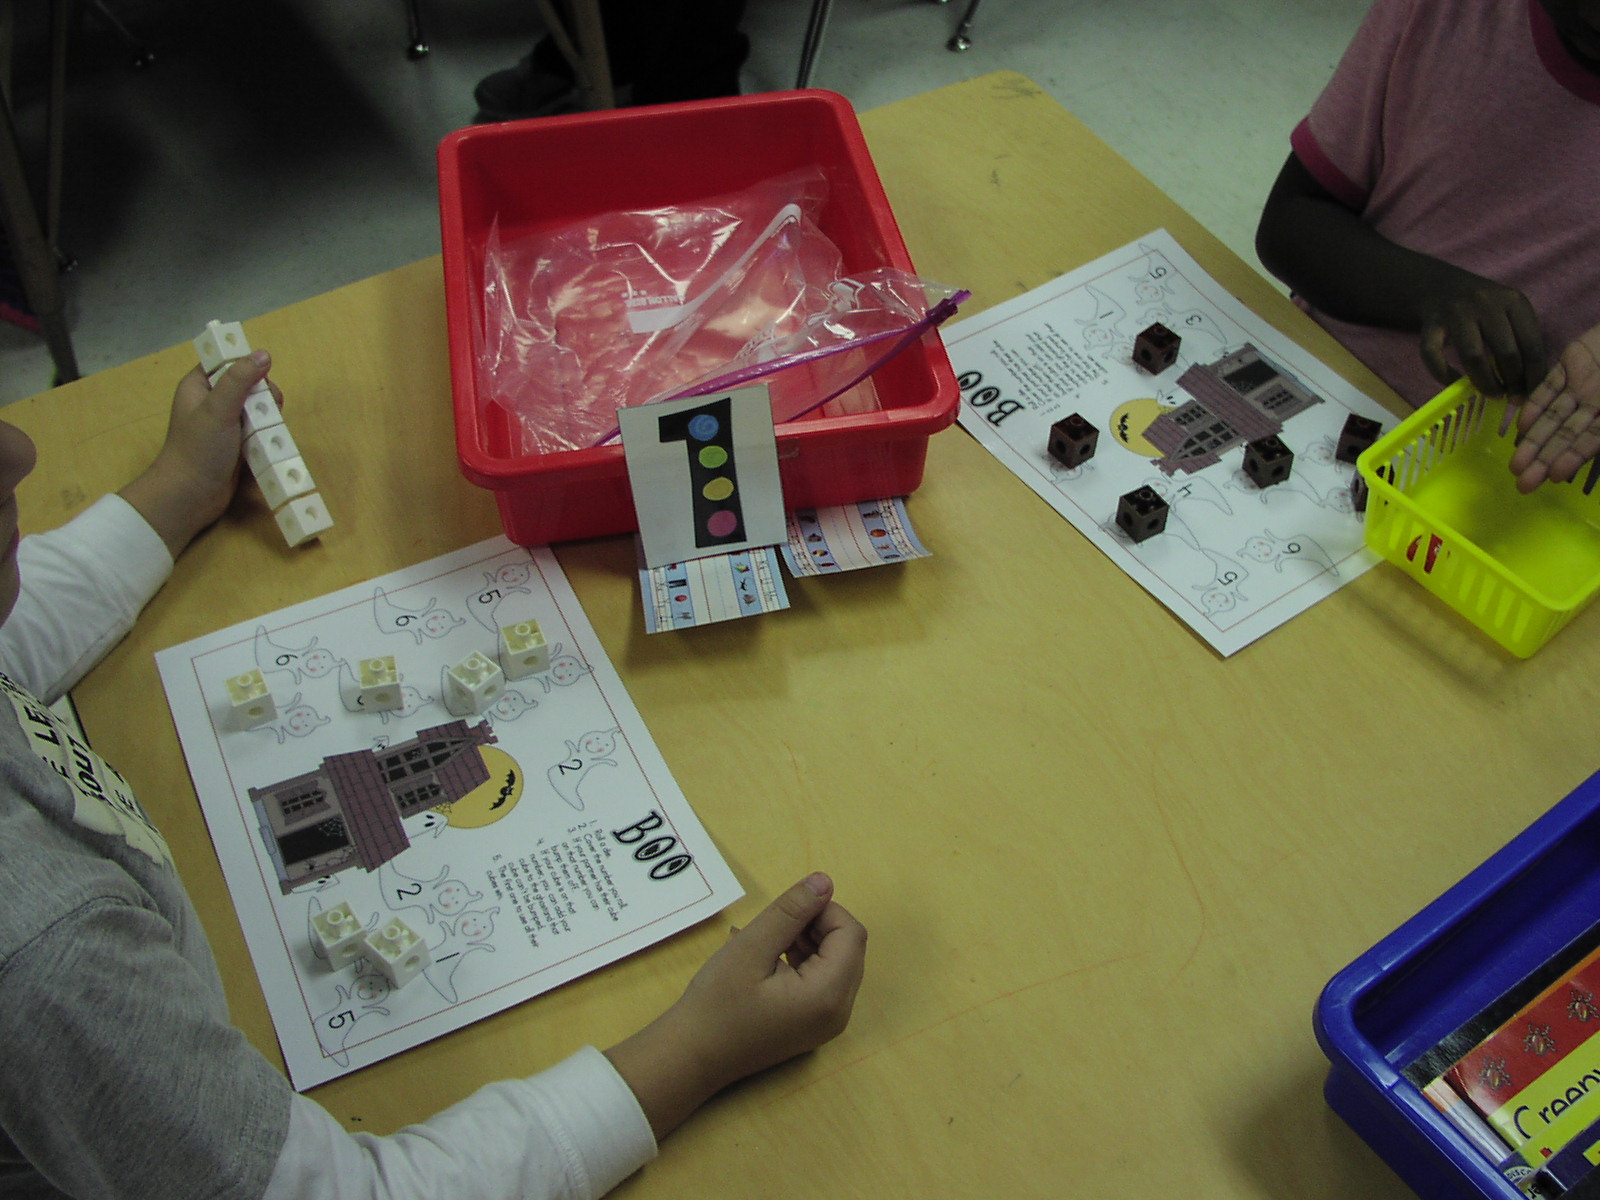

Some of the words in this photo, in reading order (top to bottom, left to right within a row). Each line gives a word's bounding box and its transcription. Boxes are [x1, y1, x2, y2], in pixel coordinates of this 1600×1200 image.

[1149, 267, 1168, 280] 5
[1185, 314, 1202, 327] 3
[957, 370, 1025, 428] BOO
[658, 397, 747, 548] 1
[1176, 484, 1193, 497] 4
[1282, 541, 1301, 555] 6
[1217, 571, 1238, 586] 5
[478, 589, 501, 606] 5
[395, 614, 417, 628] 6
[275, 652, 298, 668] 6
[558, 757, 584, 777] 2
[594, 828, 606, 841] Roll
[612, 811, 694, 881] BOO
[550, 845, 563, 863] bump
[560, 863, 571, 879] them
[583, 833, 597, 852] Cover
[594, 853, 602, 864] the
[599, 864, 614, 886] number
[608, 887, 619, 898] you
[499, 865, 507, 878] The
[508, 862, 519, 878] cube
[486, 870, 498, 889] cubes
[504, 878, 514, 891] first
[540, 879, 549, 891] you
[542, 857, 554, 870] your
[550, 871, 561, 886] cube
[566, 901, 576, 914] that
[567, 850, 577, 864] that
[574, 864, 588, 886] number
[582, 887, 593, 899] you
[590, 899, 600, 910] can
[574, 844, 586, 857] your
[580, 858, 597, 880] partner
[595, 880, 603, 892] has
[601, 892, 611, 905] their
[607, 907, 619, 922] cube
[397, 882, 422, 901] 2
[509, 892, 518, 905] one
[519, 858, 530, 874] cube
[531, 882, 539, 893] the
[550, 922, 560, 935] that
[548, 893, 557, 905] can
[519, 914, 528, 925] use
[554, 906, 567, 919] add
[524, 925, 535, 933] all
[559, 918, 571, 932] your
[529, 933, 539, 947] their
[435, 952, 460, 963] 1
[328, 1010, 356, 1030] 5
